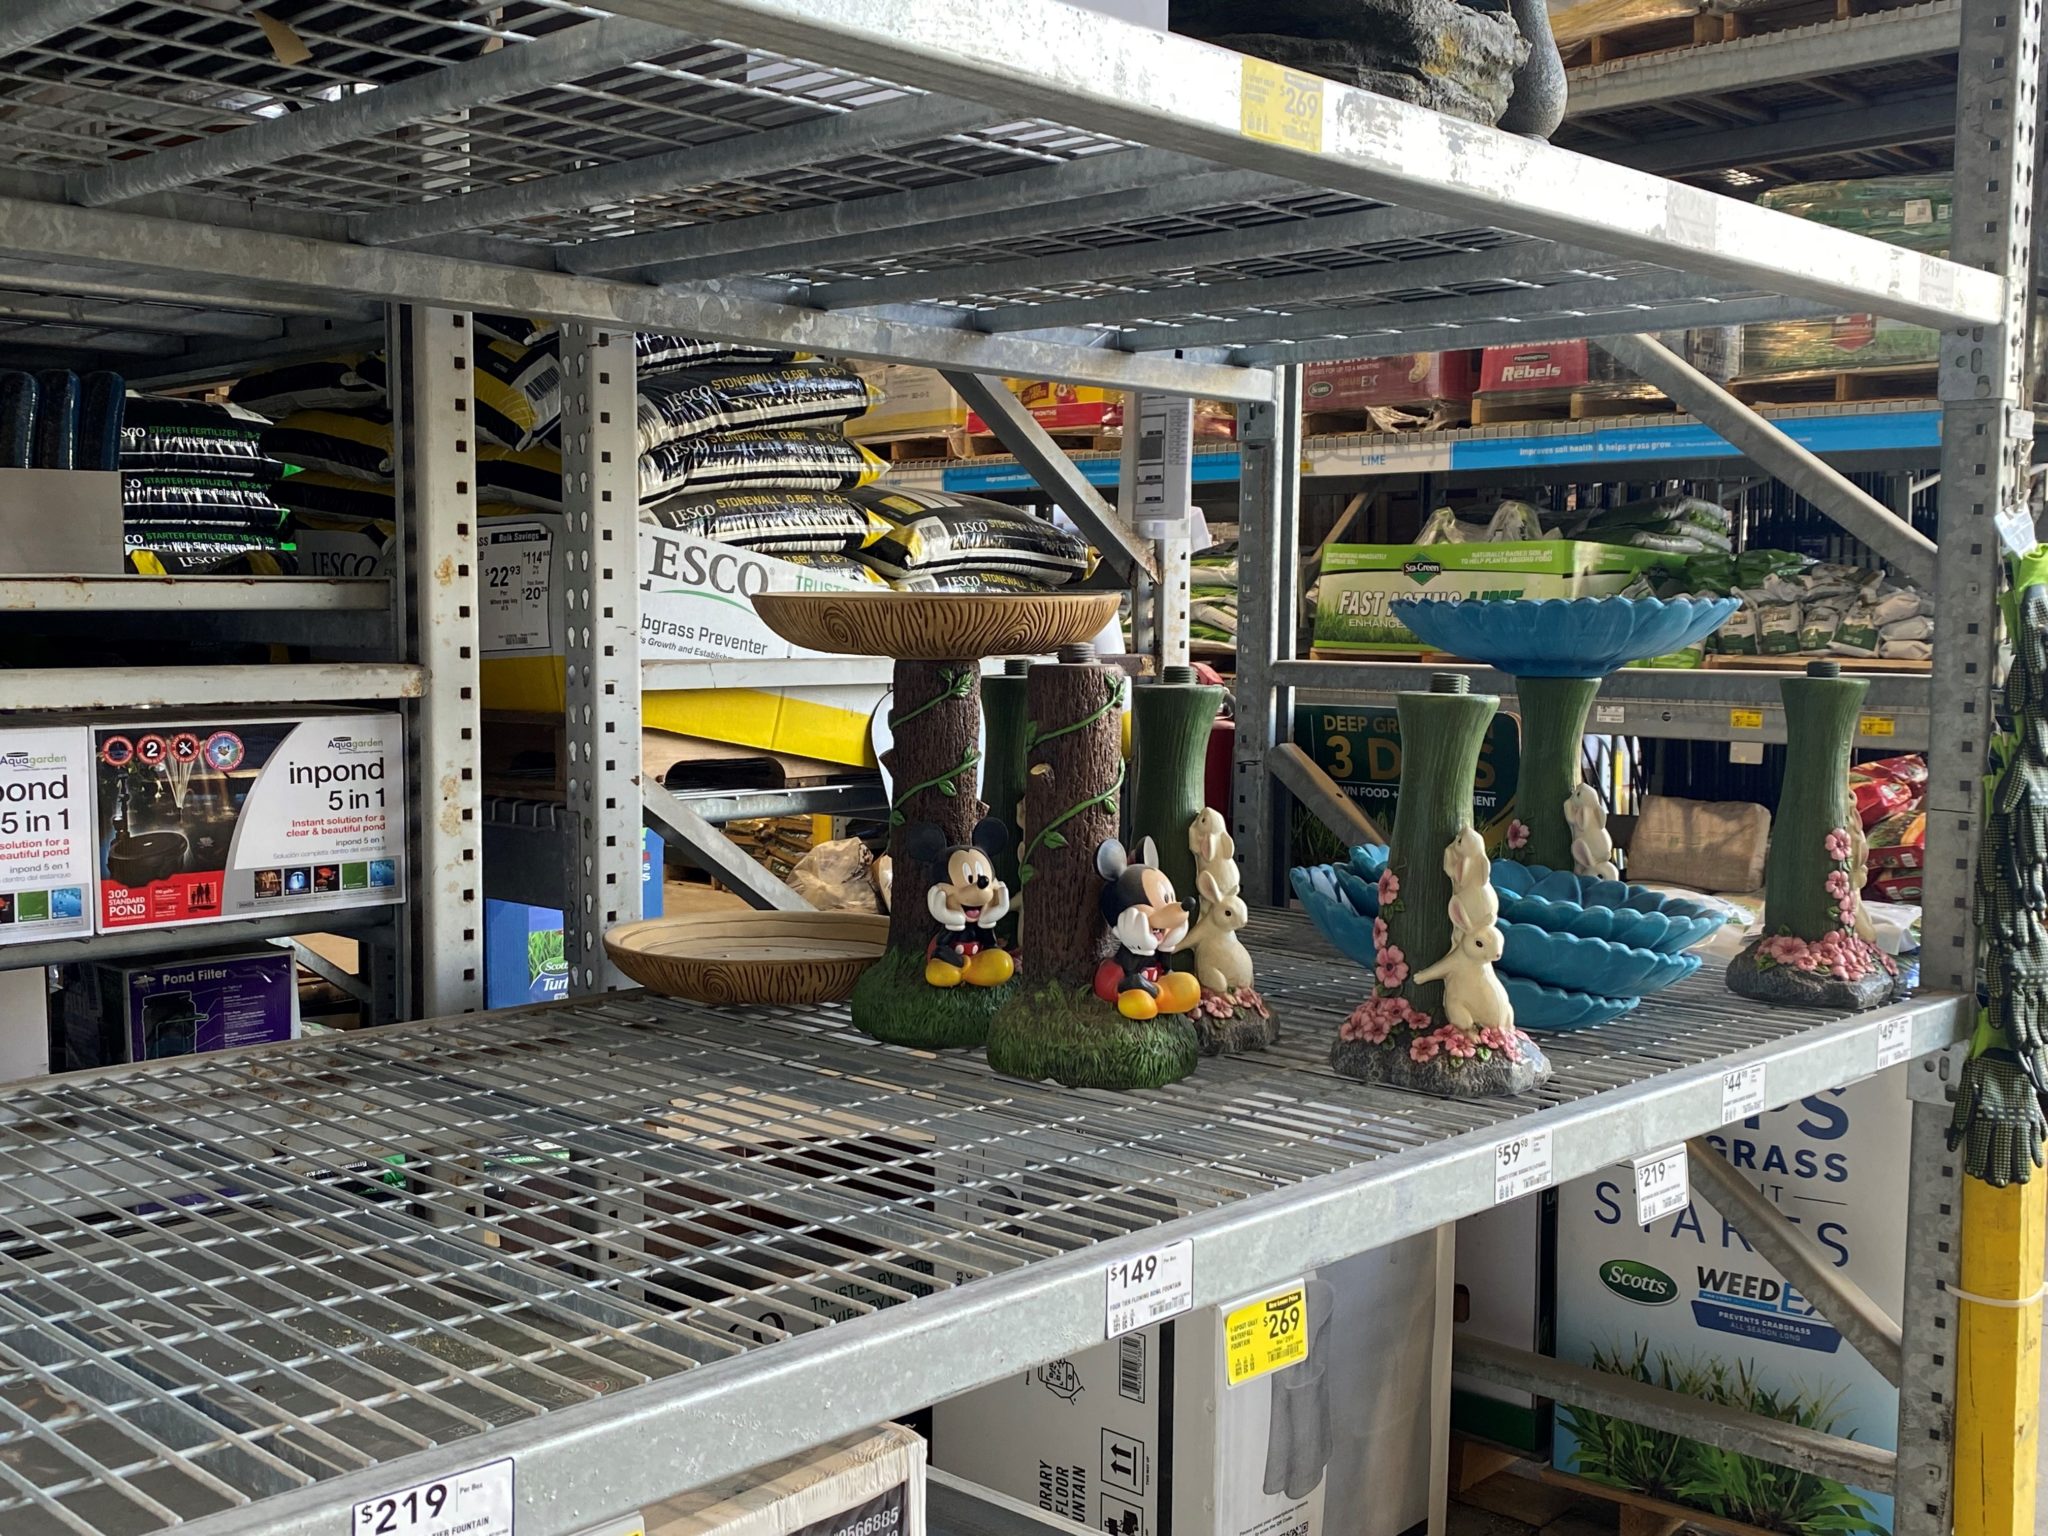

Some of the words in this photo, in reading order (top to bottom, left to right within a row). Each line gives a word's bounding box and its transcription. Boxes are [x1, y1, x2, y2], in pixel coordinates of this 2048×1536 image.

[1501, 363, 1561, 382] Rebels
[664, 385, 713, 412] LESCO
[711, 373, 774, 390] STONEWALL
[150, 426, 189, 434] STARTER
[190, 427, 239, 438] FERTILIZER
[664, 438, 709, 465] LESCO
[709, 432, 774, 444] STONEWALL
[1569, 444, 1594, 453] health
[1605, 442, 1627, 452] helps
[1628, 442, 1650, 452] grass
[1361, 454, 1387, 466] LIME
[143, 477, 184, 485] STARTER
[185, 477, 234, 487] FERTILIZER
[668, 504, 716, 528] LESCO
[716, 494, 781, 509] STONEWALL
[787, 494, 816, 504] 0.68%
[145, 532, 184, 540] STARTER
[186, 532, 234, 541] FERTILIZER
[514, 532, 540, 541] Savings
[952, 521, 988, 537] LESCO
[640, 532, 769, 600] ESCO
[1405, 562, 1440, 572] Sta-Green
[944, 575, 981, 588] LESCO
[980, 572, 1027, 590] STONEWALL
[1338, 591, 1385, 617] FAST
[647, 636, 677, 651] Growth
[677, 643, 693, 655] and
[698, 626, 769, 656] Preventer
[1323, 715, 1368, 733] DEEP
[146, 742, 158, 757] 2
[327, 737, 384, 752] Aquagarden
[0, 751, 68, 767] Aquagarden
[1326, 735, 1354, 778] 3
[289, 757, 385, 788] inpond
[328, 789, 344, 811] 5
[349, 788, 370, 810] in
[375, 787, 385, 807] 1
[1359, 787, 1390, 799] FOOD
[1, 811, 19, 835] 5
[26, 810, 51, 833] in
[57, 807, 70, 830] 1
[292, 816, 325, 828] Instant
[326, 814, 363, 826] solution
[365, 814, 378, 822] for
[286, 827, 309, 838] clear
[311, 827, 320, 836] &
[321, 823, 361, 835] beautiful
[362, 822, 386, 833] pond
[45, 837, 60, 847] for
[62, 838, 70, 846] a
[335, 837, 362, 847] inpond
[363, 837, 369, 845] 5
[42, 847, 70, 859] pond
[9, 863, 42, 874] inpond
[43, 862, 50, 871] 5
[107, 889, 129, 899] 300
[108, 896, 146, 906] STANDARD
[109, 903, 146, 917] POND
[162, 971, 195, 985] Pond
[197, 968, 228, 981] Filter
[1639, 1162, 1666, 1188] $219
[1594, 1180, 1849, 1268] SARS
[878, 1271, 895, 1286] BY
[1110, 1254, 1158, 1289] $149
[1608, 1264, 1669, 1296] Scotts
[1161, 1281, 1182, 1294] FOUNTAIN
[1263, 1306, 1300, 1339] $269
[1718, 1310, 1760, 1327] PREVENTS
[1761, 1320, 1812, 1336] CRABGRASS
[1730, 1322, 1746, 1332] ALL
[1747, 1324, 1778, 1339] SEASON
[1780, 1330, 1801, 1342] LONG
[459, 1486, 470, 1495] Per
[471, 1482, 483, 1491] Box
[1056, 1466, 1069, 1517] FLOOR
[1072, 1465, 1086, 1523] UNTAIN
[361, 1483, 448, 1536] $219
[451, 1516, 490, 1535] FOUNTAIN
